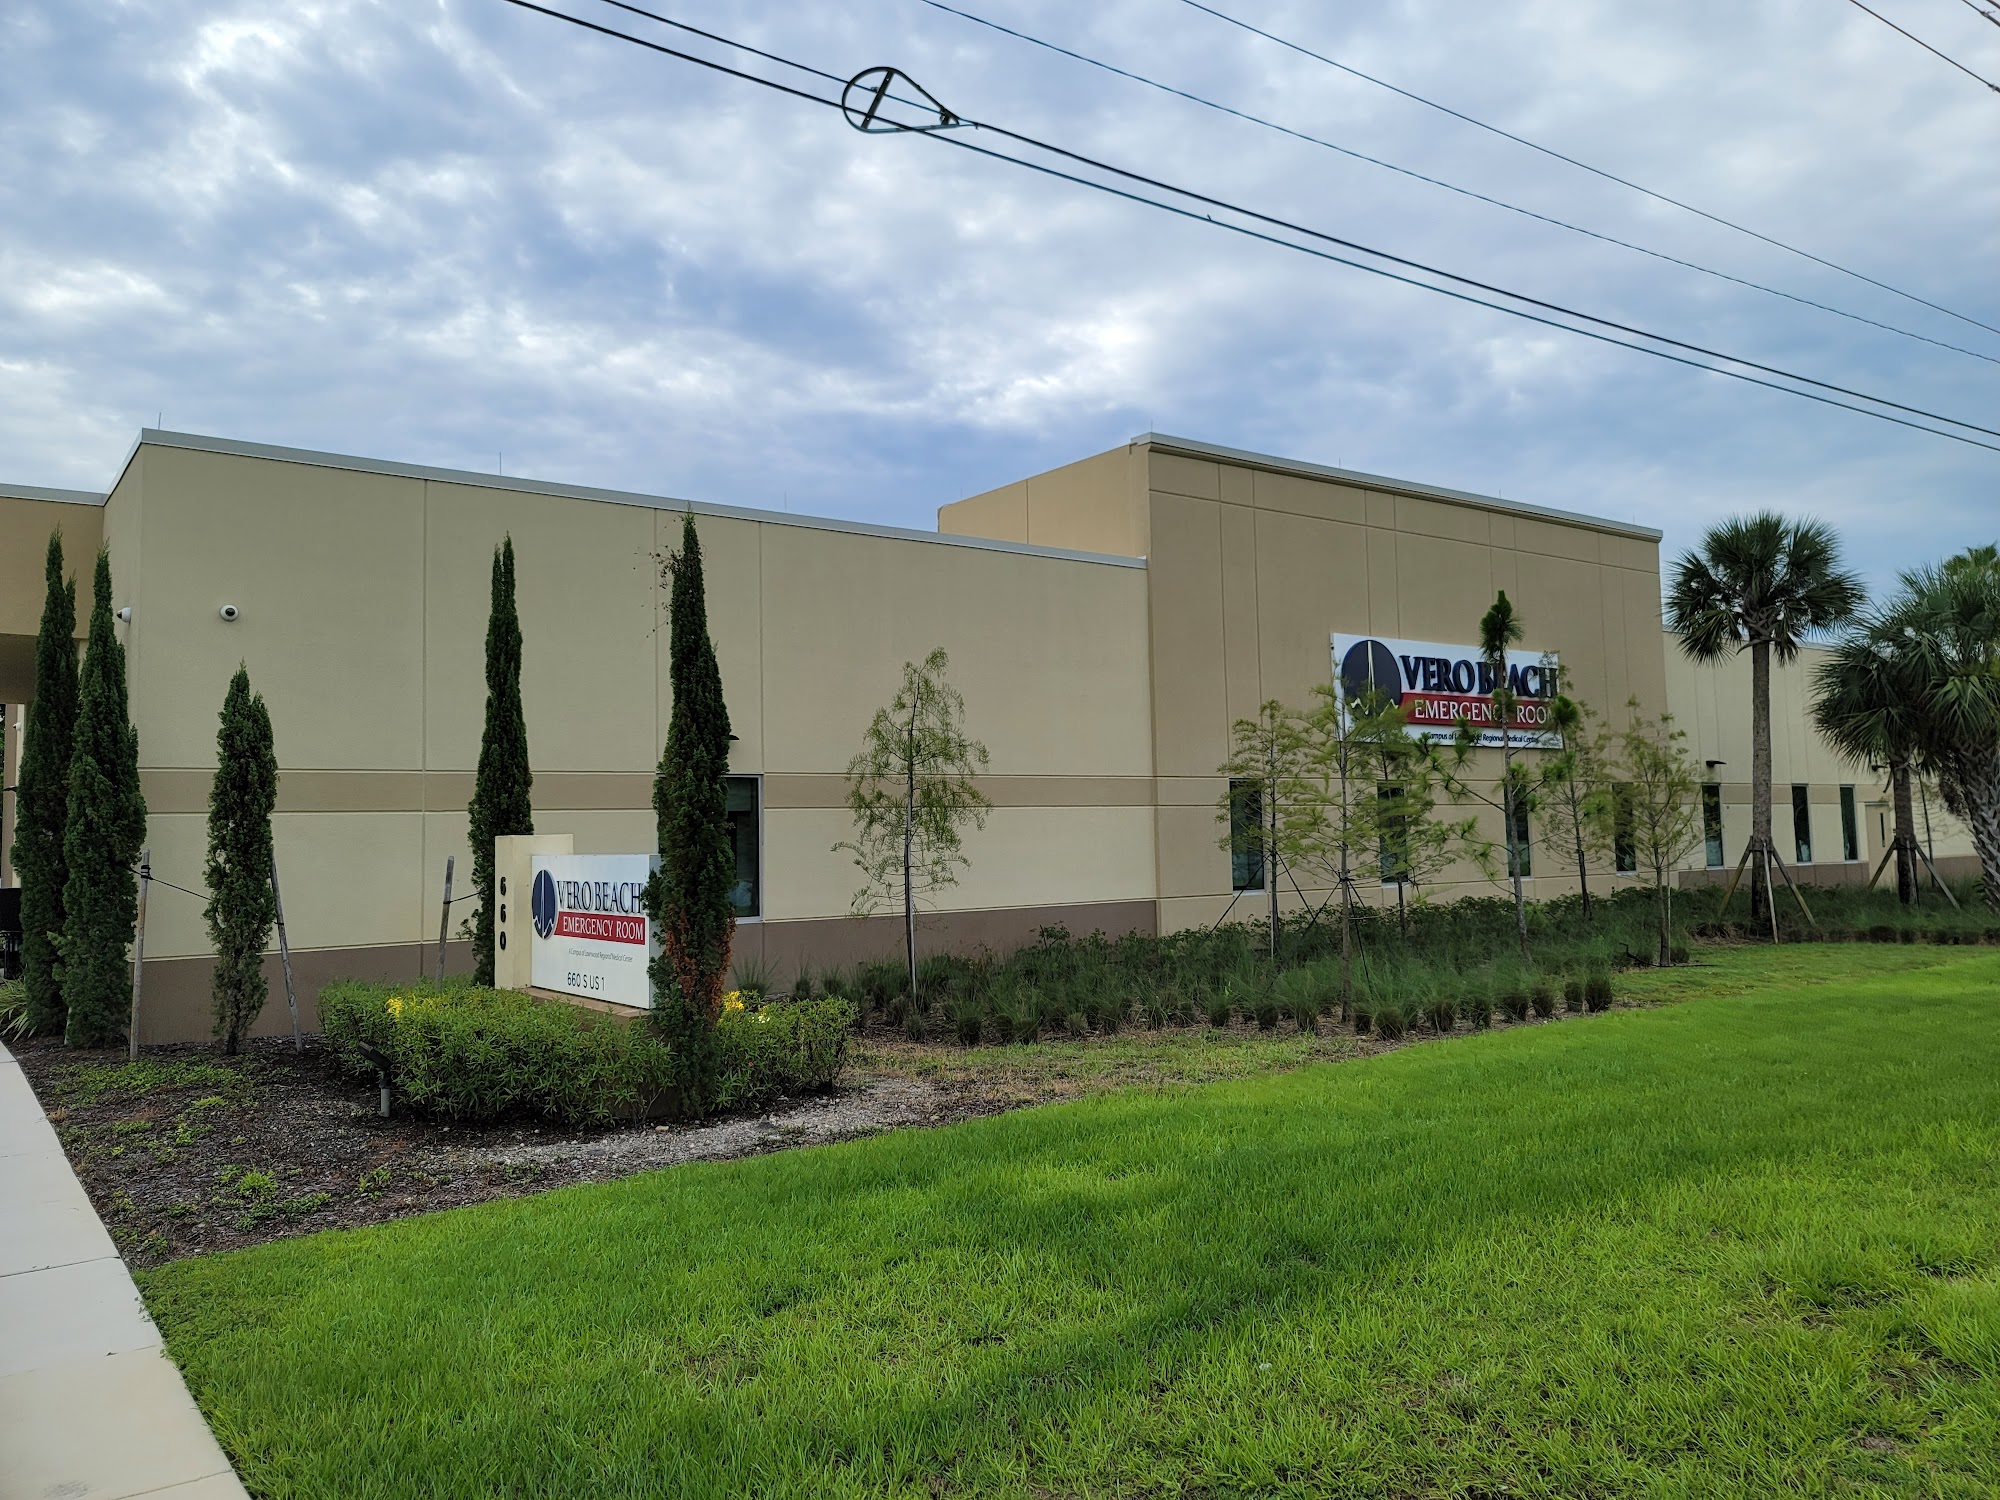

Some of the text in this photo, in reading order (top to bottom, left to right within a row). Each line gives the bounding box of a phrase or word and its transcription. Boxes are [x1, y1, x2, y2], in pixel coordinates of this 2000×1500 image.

[1400, 655, 1475, 693] VERO
[1415, 700, 1510, 723] EMERGENC
[557, 881, 642, 914] VERO BEACH
[563, 916, 644, 941] EMERGENCY ROOM
[567, 972, 605, 991] 660 S US 1
